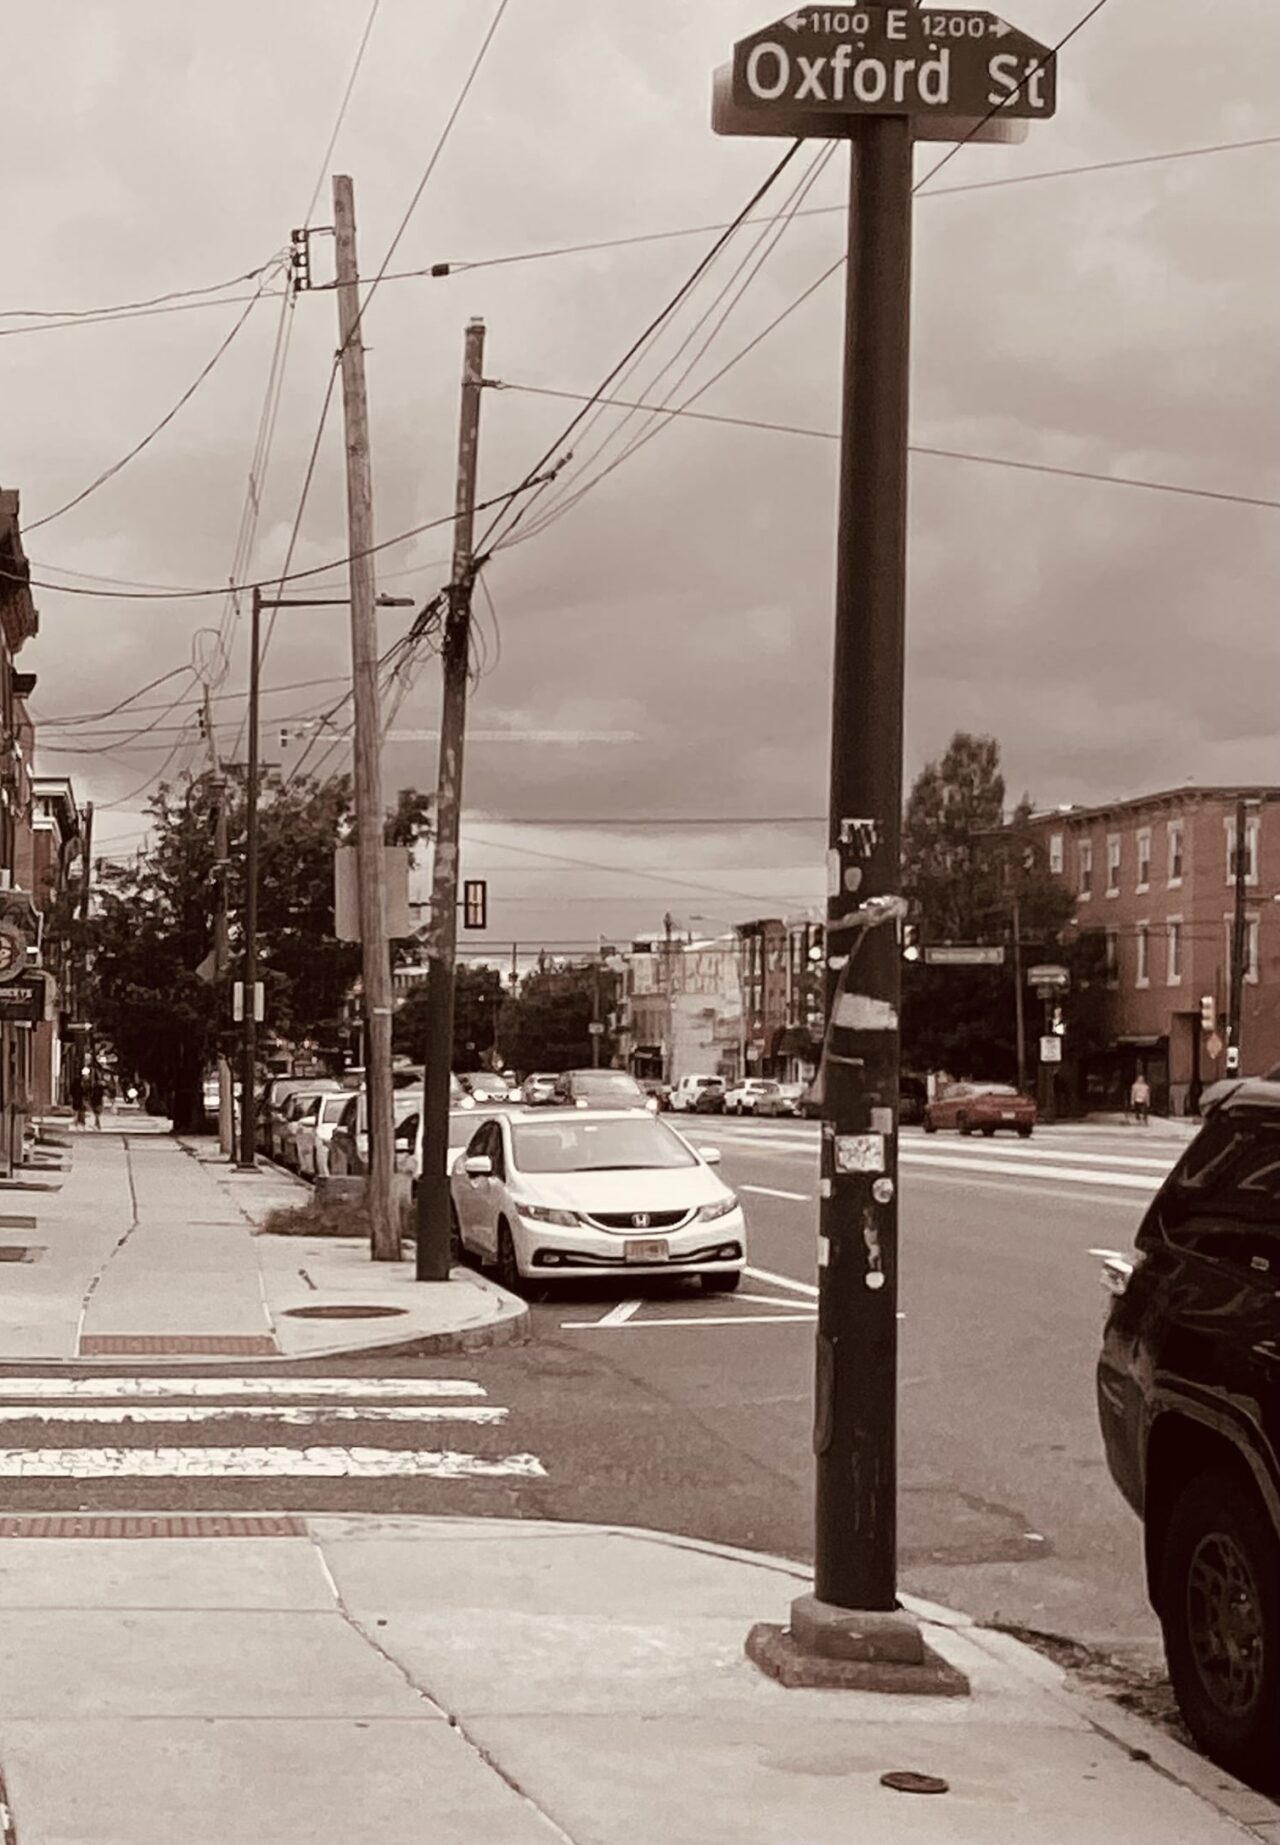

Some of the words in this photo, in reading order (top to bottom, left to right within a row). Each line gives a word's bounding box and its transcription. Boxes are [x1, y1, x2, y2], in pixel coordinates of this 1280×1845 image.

[810, 12, 870, 34] 1100
[886, 10, 908, 40] E
[922, 16, 986, 38] 1200
[746, 41, 950, 104] Oxford
[987, 53, 1045, 108] St
